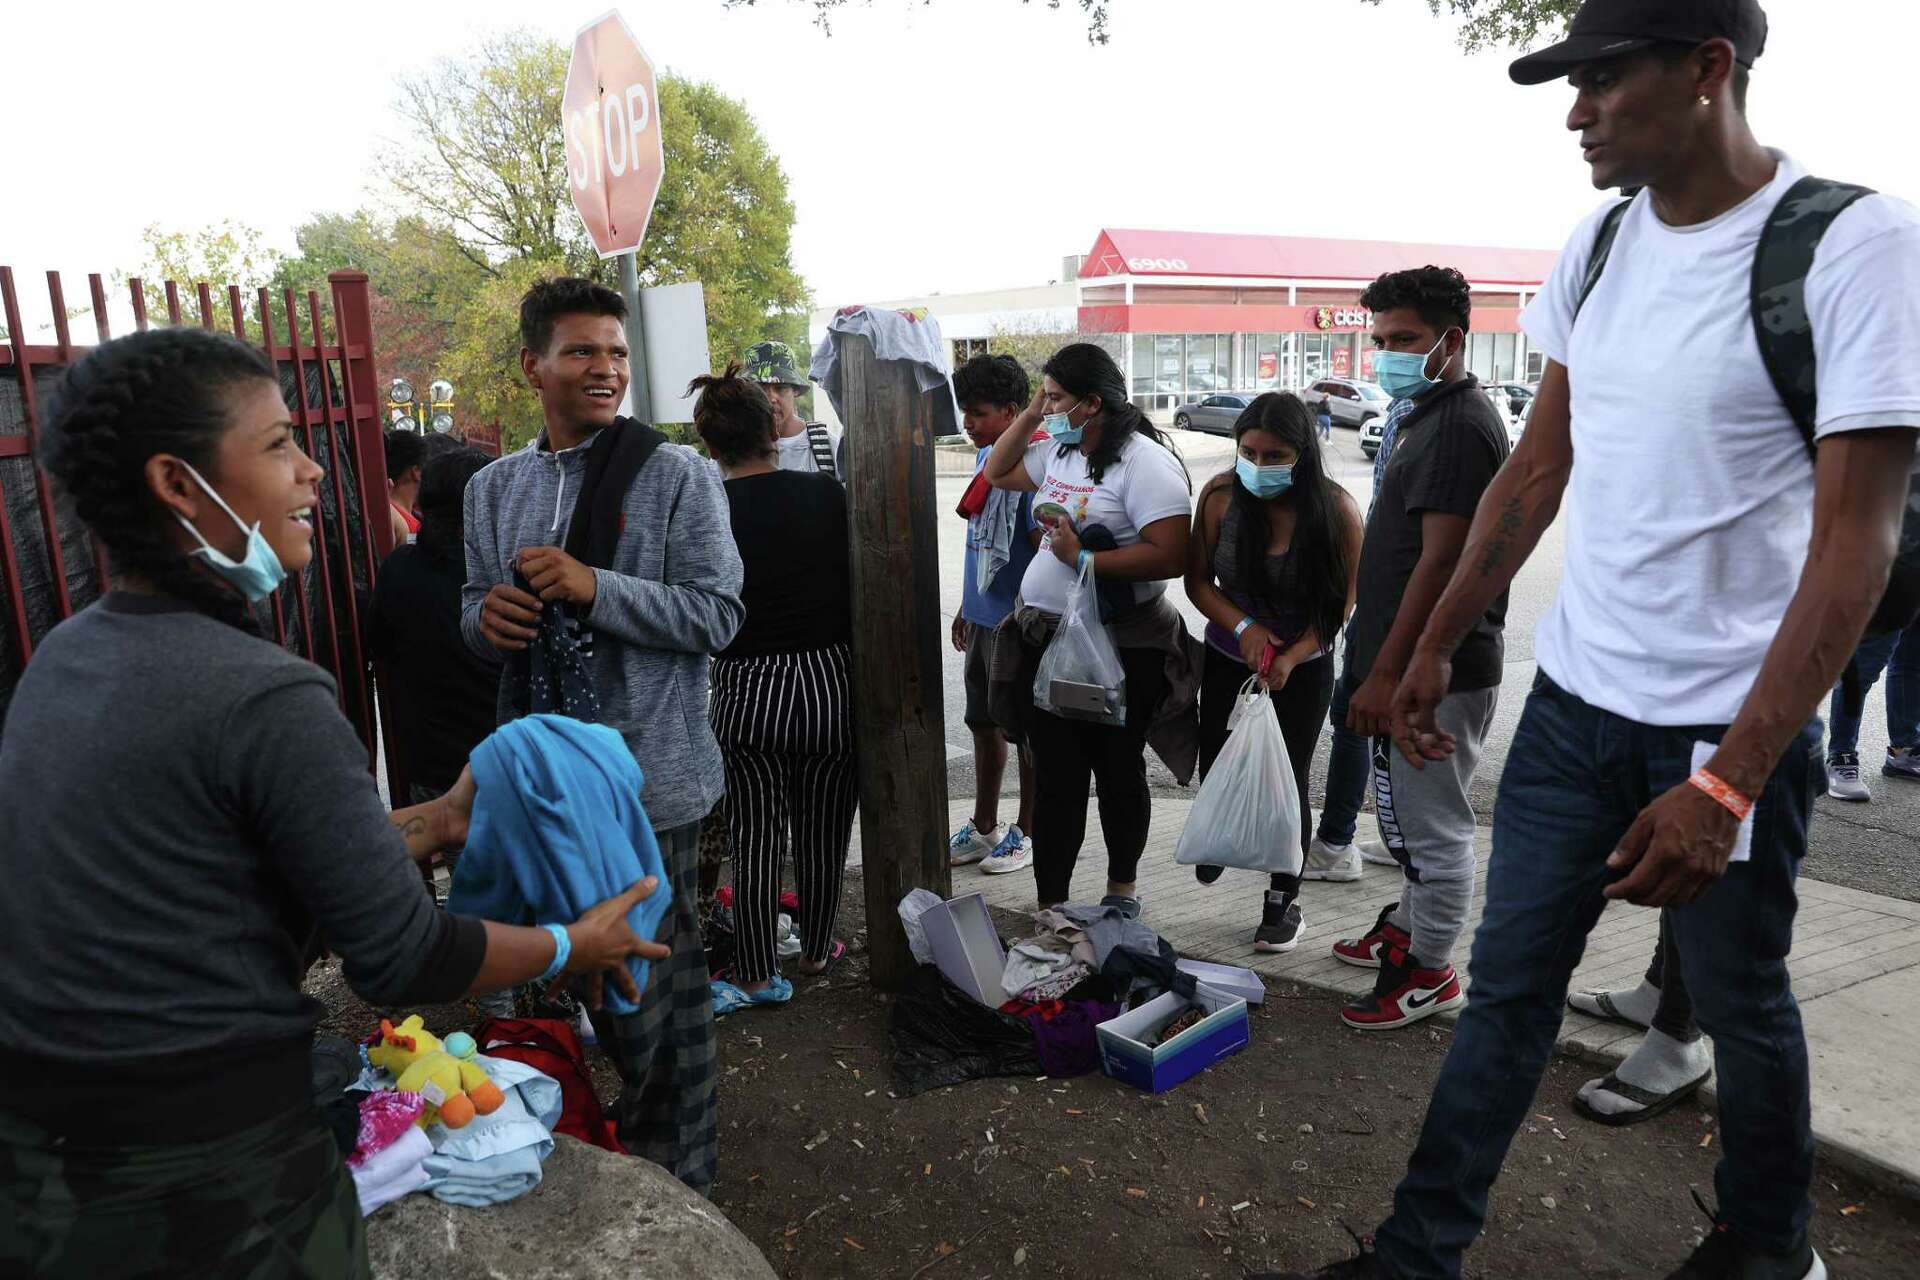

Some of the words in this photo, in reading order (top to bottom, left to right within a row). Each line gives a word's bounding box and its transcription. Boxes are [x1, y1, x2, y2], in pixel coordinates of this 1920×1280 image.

[571, 83, 649, 191] STOP
[1129, 258, 1188, 271] 6900
[1049, 490, 1069, 504] #5
[1374, 767, 1404, 849] JORDAN
